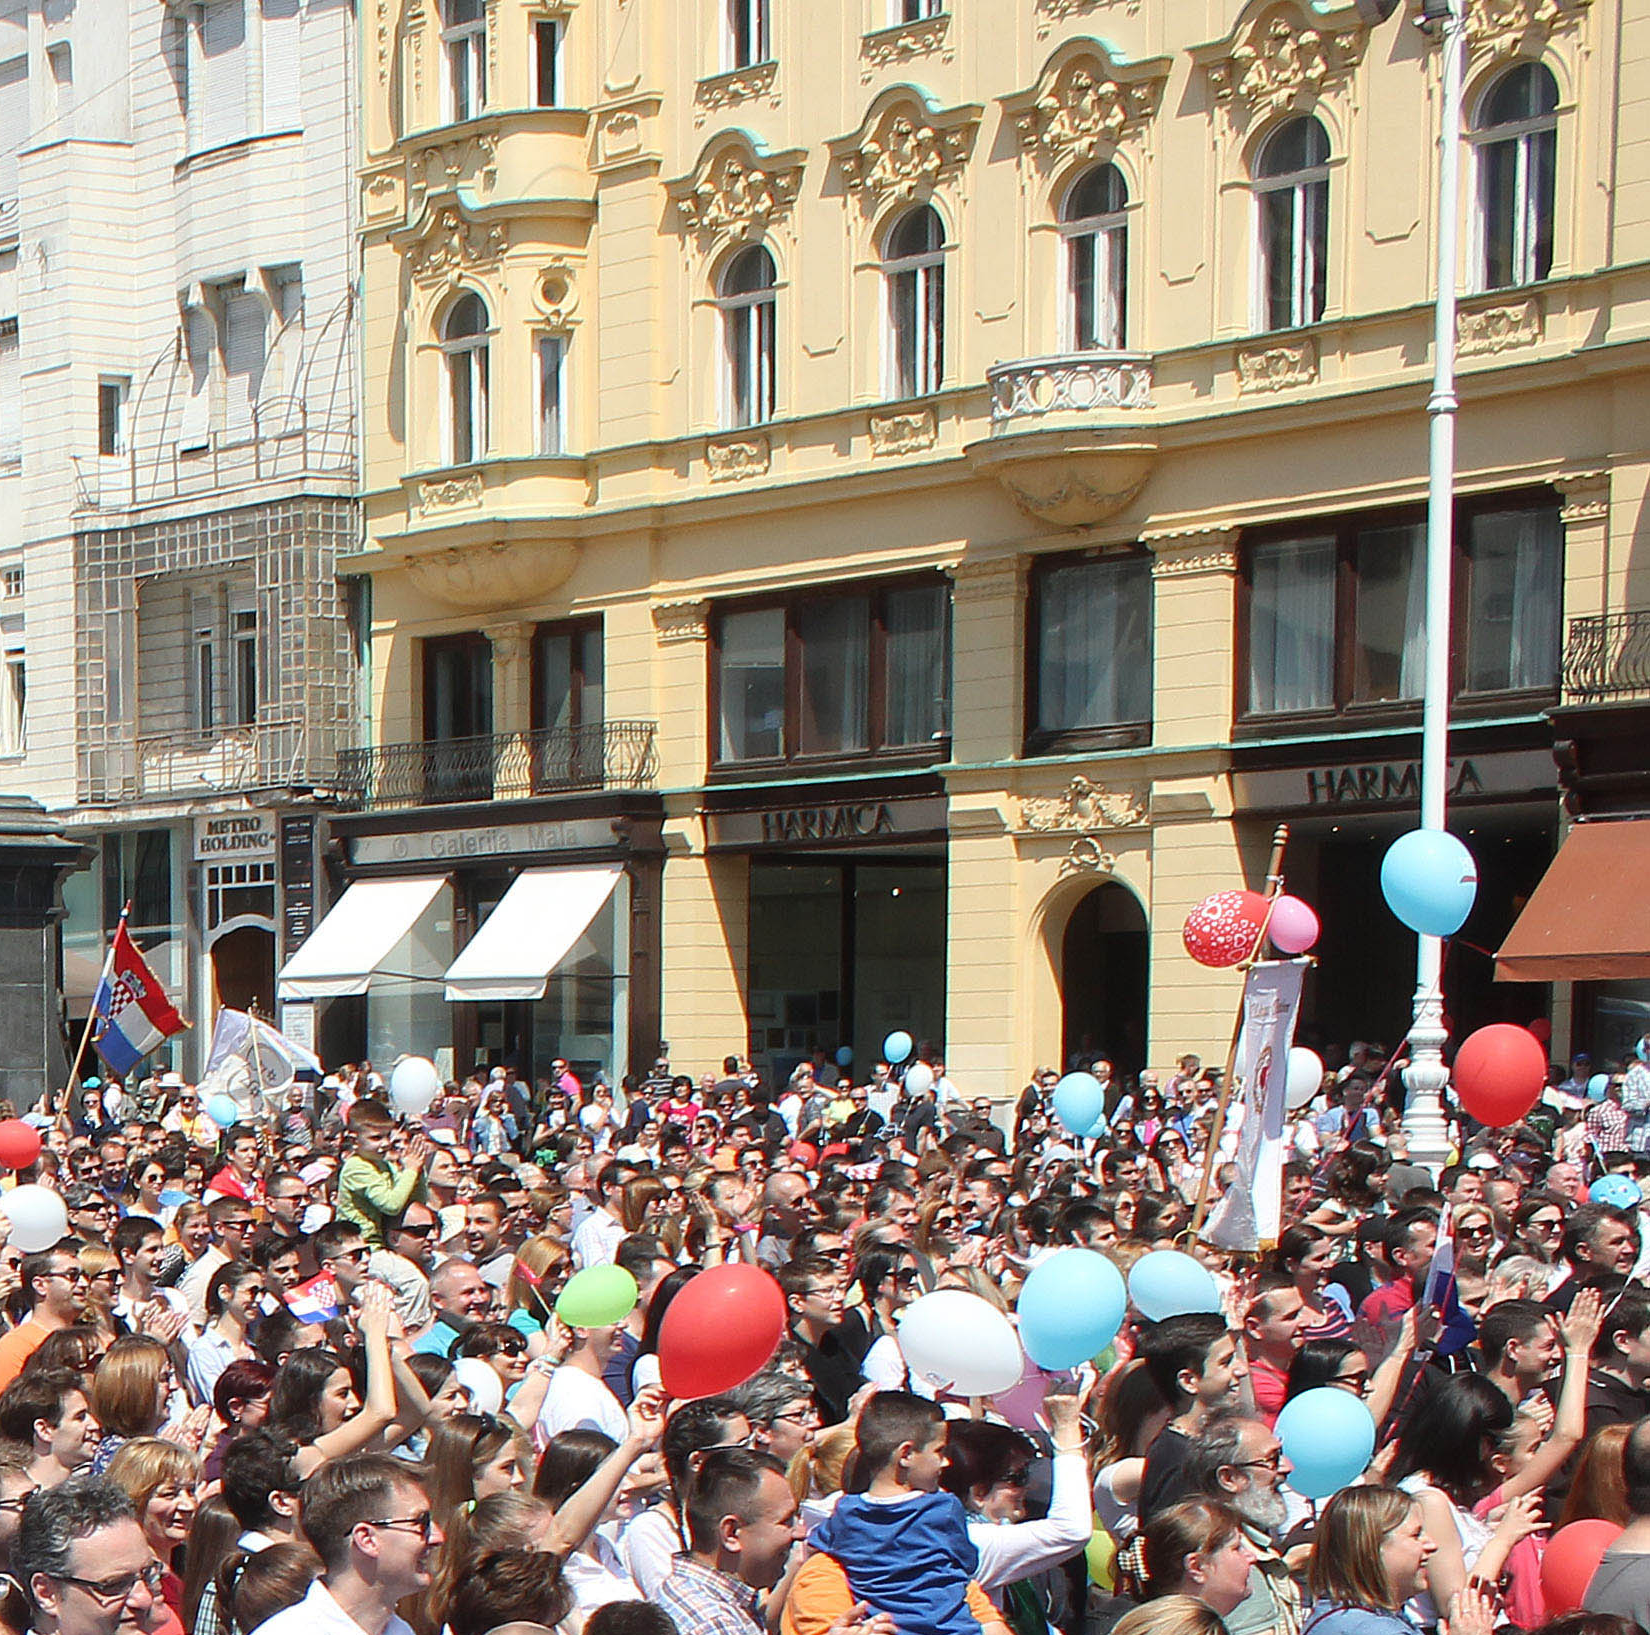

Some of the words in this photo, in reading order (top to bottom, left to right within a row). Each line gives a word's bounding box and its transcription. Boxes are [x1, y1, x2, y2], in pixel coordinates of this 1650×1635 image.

[1307, 759, 1484, 803] HARMA
[206, 816, 261, 835] METRO
[430, 829, 510, 857] Galerija
[527, 822, 579, 850] Mala
[761, 802, 895, 843] HARMICA
[201, 832, 270, 853] HOLDING
